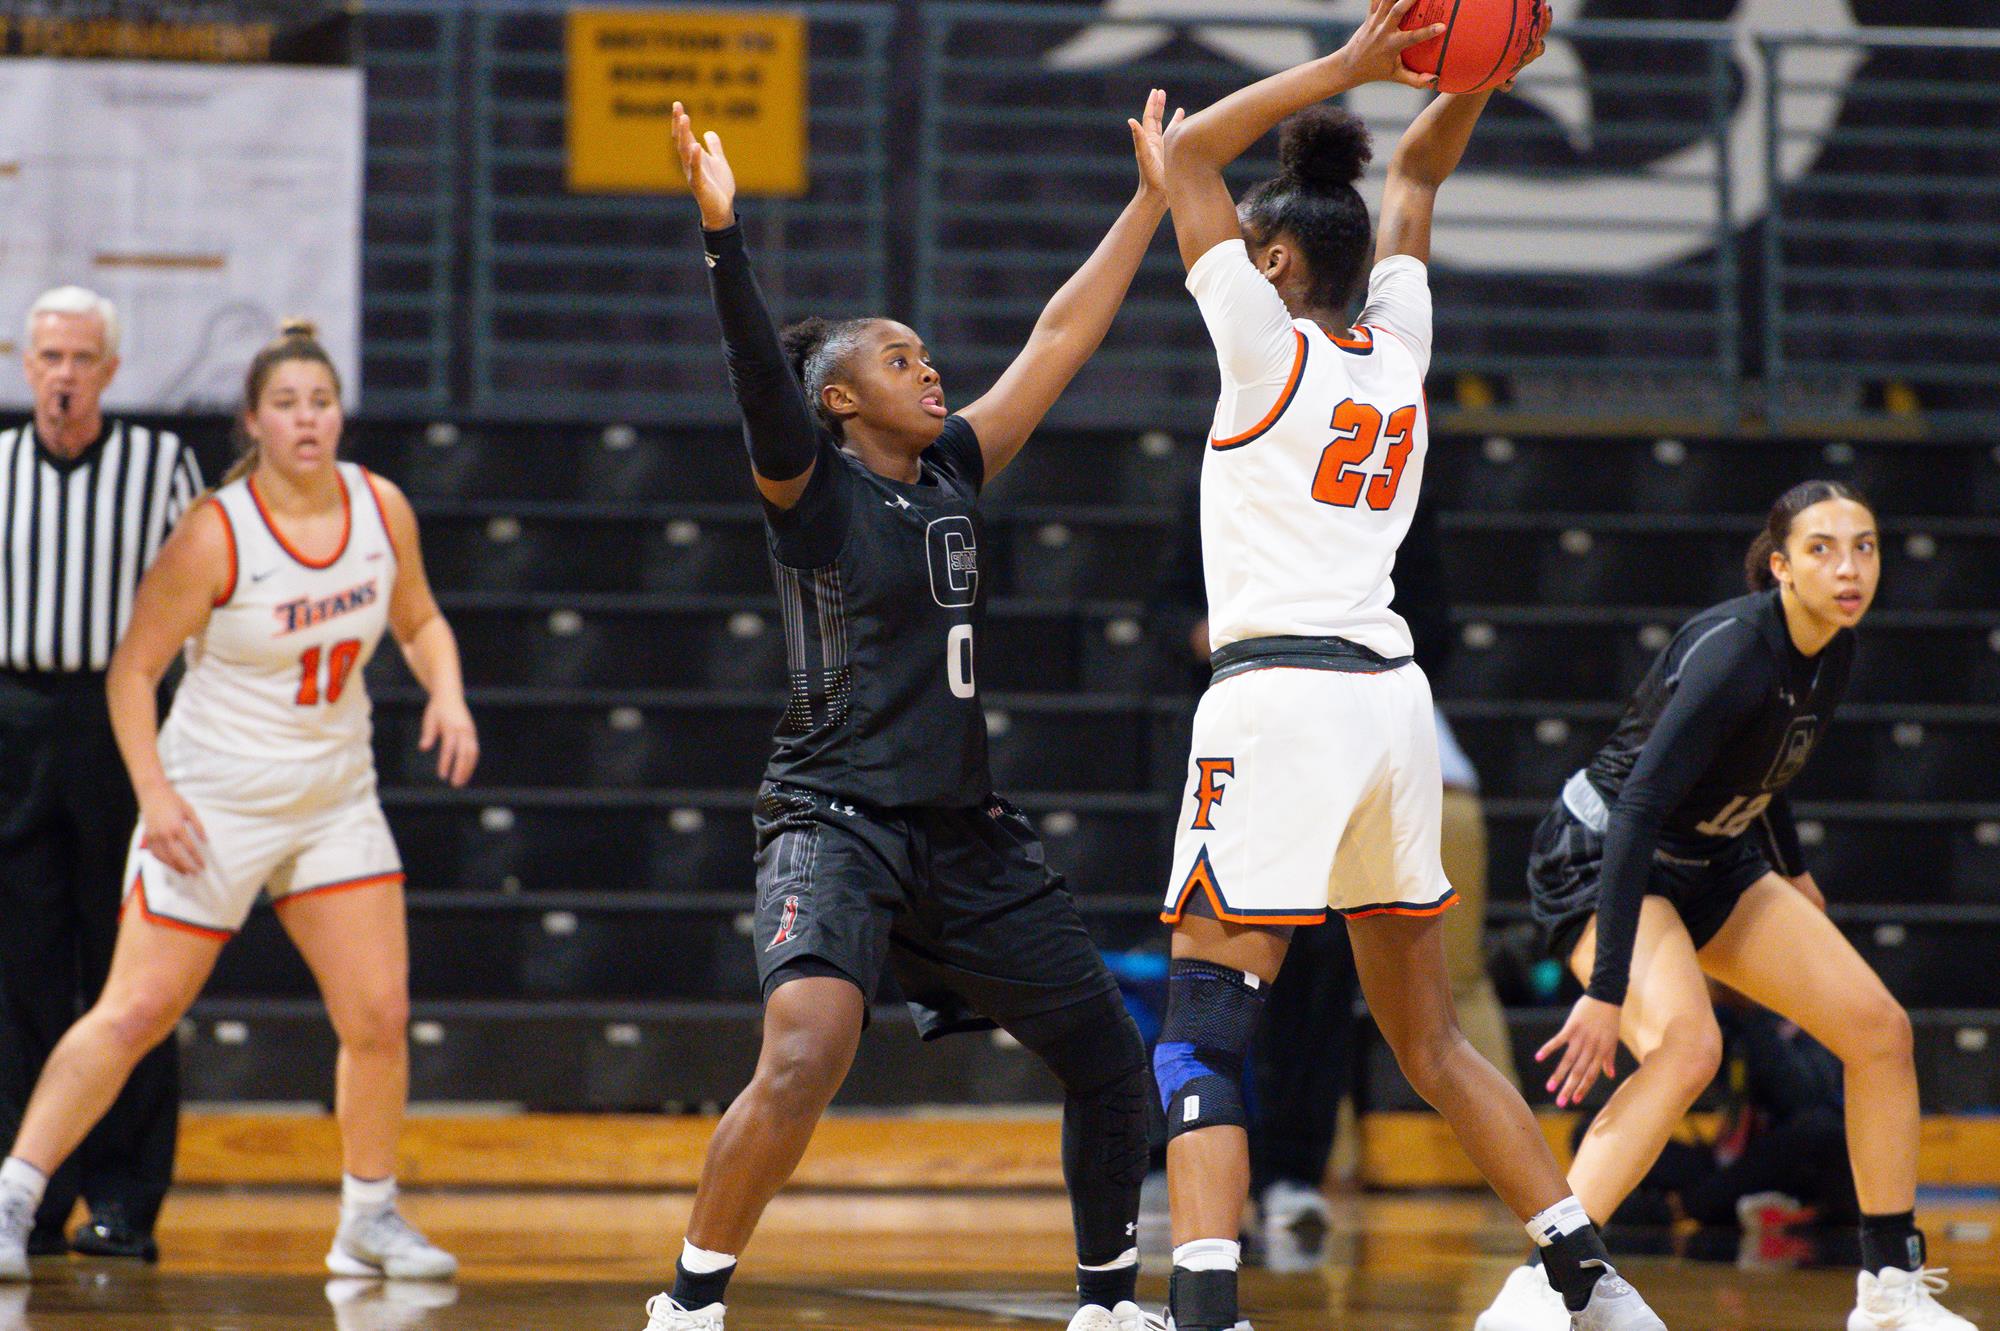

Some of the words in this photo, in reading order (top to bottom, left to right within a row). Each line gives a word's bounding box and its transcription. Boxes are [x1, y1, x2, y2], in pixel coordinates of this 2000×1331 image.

[1311, 397, 1417, 511] 23
[926, 515, 979, 608] C
[295, 638, 362, 706] 10
[947, 624, 976, 699] 0
[1190, 757, 1236, 830] F
